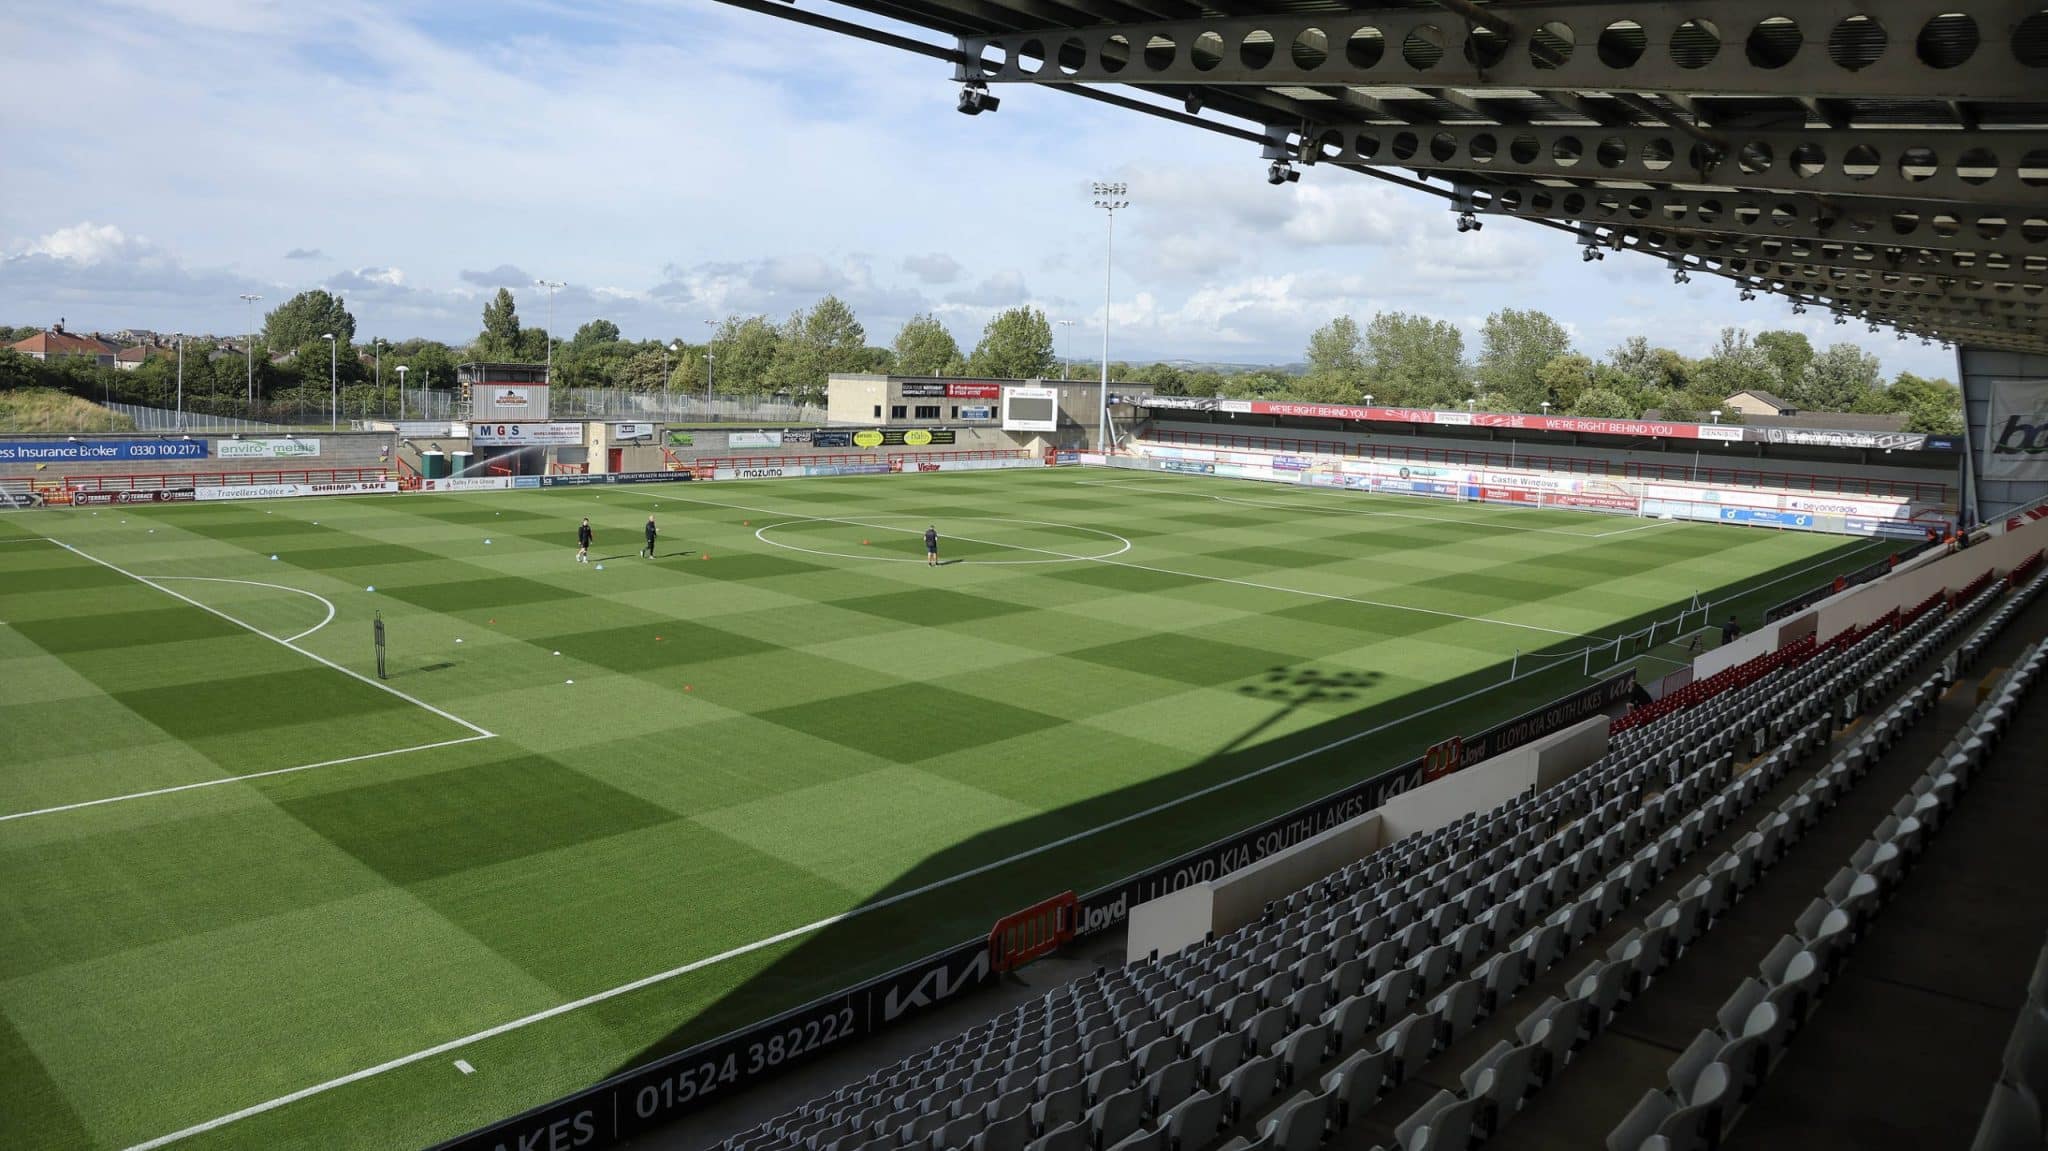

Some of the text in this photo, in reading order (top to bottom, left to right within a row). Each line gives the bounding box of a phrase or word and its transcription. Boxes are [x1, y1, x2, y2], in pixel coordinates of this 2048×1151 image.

[1269, 404, 1368, 418] WE'RE RIGHT BEHIND YOU
[480, 425, 520, 436] M G S
[1546, 418, 1673, 436] WE'RE RIGHT BEHIND YOU
[18, 446, 78, 458] Insurance
[80, 445, 118, 457] Broker
[130, 445, 155, 456] 0330
[158, 444, 178, 455] 100
[179, 444, 201, 455] 2171
[743, 468, 782, 478] mazuma
[917, 462, 941, 472] Visitor
[311, 484, 351, 492] SHRIMP
[1491, 475, 1559, 488] Castle Windows
[217, 487, 284, 497] Travellers Choice
[1803, 502, 1858, 514] beyondradio
[1496, 724, 1527, 751] LLOYD
[1528, 715, 1545, 737] KIA
[1546, 703, 1576, 729] SOUTH
[1577, 692, 1602, 715] LAKES
[1220, 843, 1250, 877] KIA
[1255, 820, 1312, 861] SOUTH
[1317, 795, 1363, 833] LAKES
[635, 1053, 738, 1118] 01524
[747, 1007, 855, 1074] 382222
